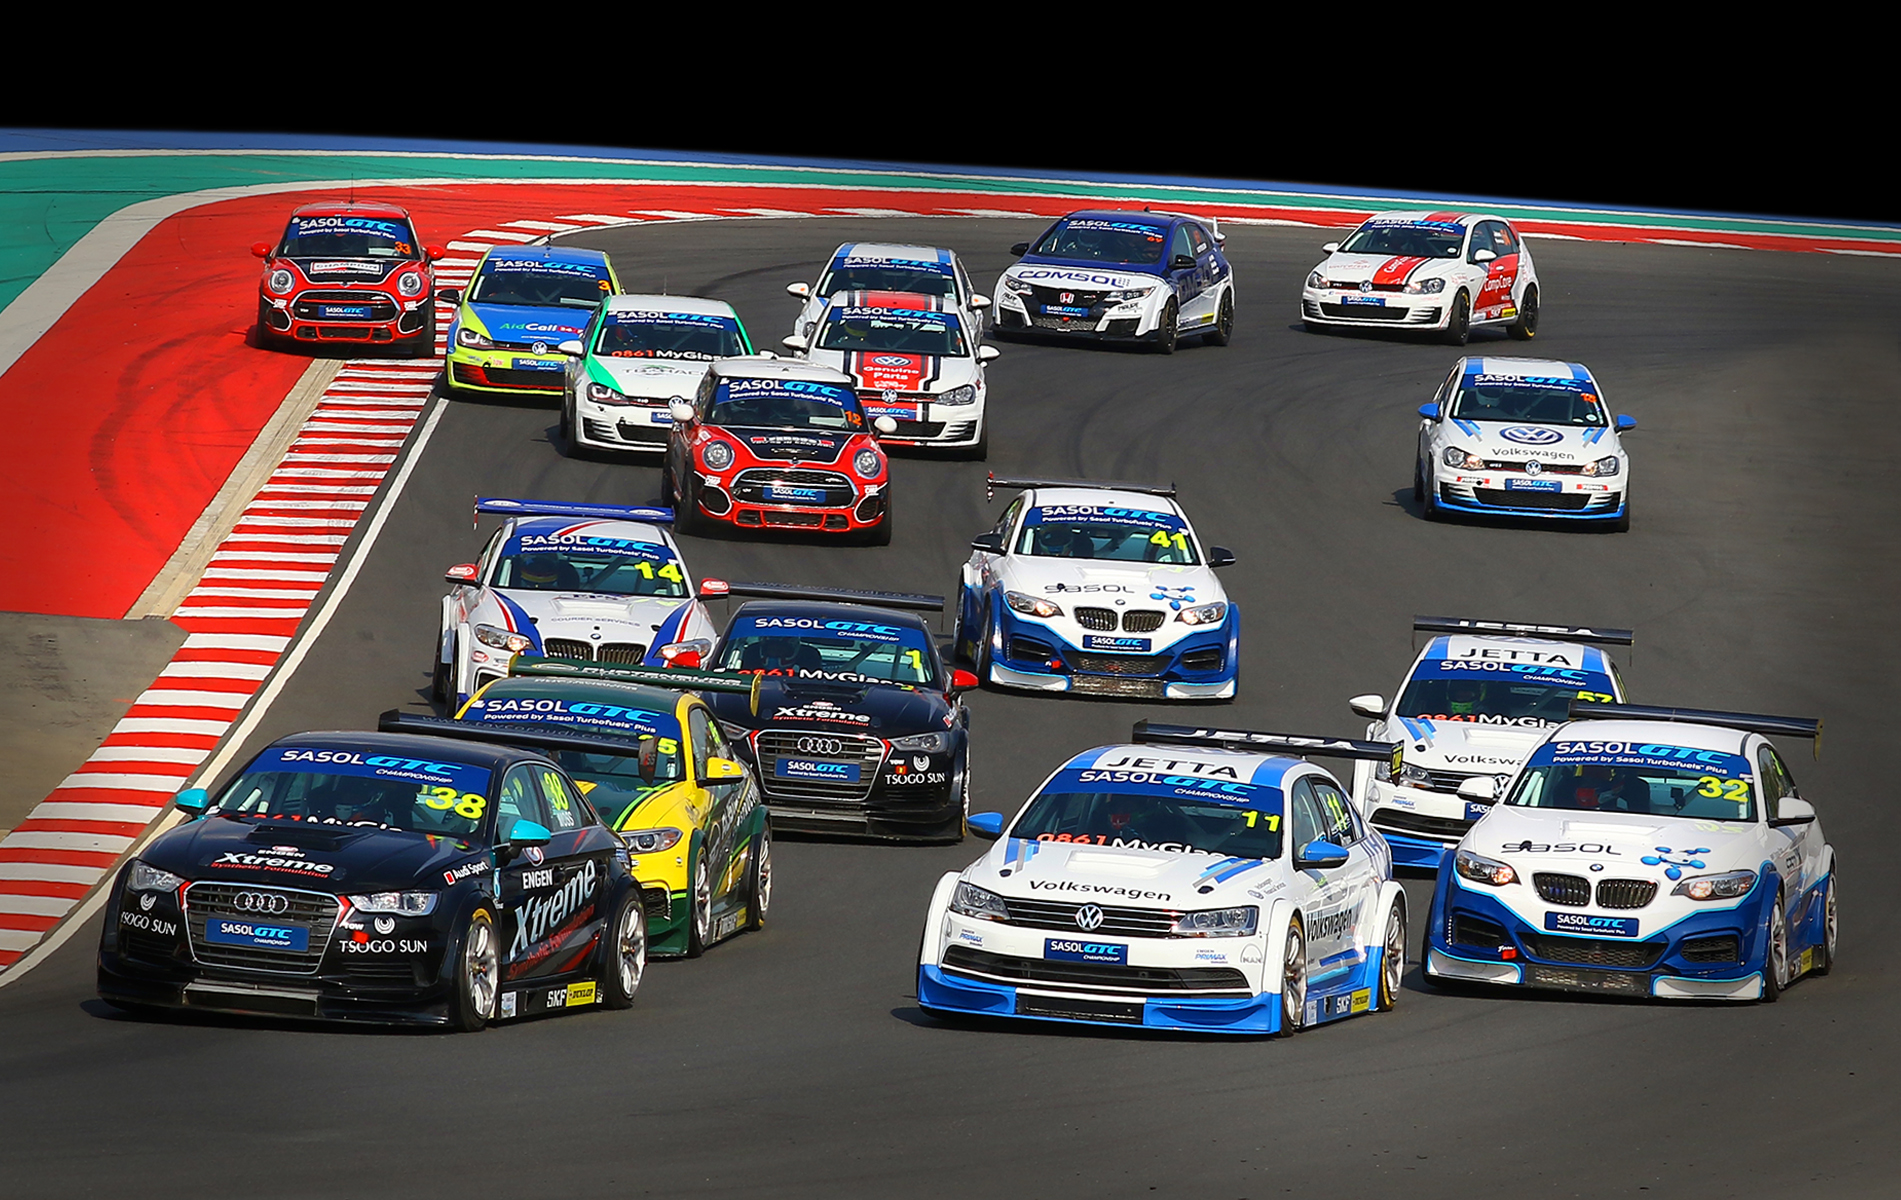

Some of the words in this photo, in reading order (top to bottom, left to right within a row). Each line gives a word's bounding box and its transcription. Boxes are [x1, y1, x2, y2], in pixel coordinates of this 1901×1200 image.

[299, 218, 345, 230] SASOL
[345, 218, 396, 232] GTC
[1110, 222, 1158, 232] GTC
[394, 241, 411, 255] 33
[495, 260, 543, 268] SASOL
[543, 262, 596, 273] GTC
[844, 256, 890, 265] SASOL
[890, 258, 941, 268] GTC
[598, 280, 611, 291] 3
[1017, 270, 1123, 288] COMSOL
[617, 311, 668, 319] SASOL
[668, 313, 723, 323] GTC
[842, 307, 892, 315] SASOL
[891, 309, 946, 320] GTC
[500, 323, 557, 332] AidCall
[611, 349, 654, 357] 0861
[863, 365, 919, 374] Genuine
[873, 371, 908, 380] Parts
[729, 380, 784, 393] SASOL
[784, 381, 842, 397] GTC
[1474, 374, 1525, 382] SASOL
[1525, 376, 1581, 387] GTC
[845, 410, 862, 426] 12
[1492, 448, 1575, 460] Volkswagen
[1042, 506, 1104, 516] SASOL
[1103, 507, 1170, 522] GTC
[1155, 522, 1172, 530] Plus
[520, 536, 587, 546] SASOL
[587, 537, 658, 552] GTC
[1150, 530, 1187, 550] 41
[521, 545, 559, 553] Powered
[641, 552, 660, 560] Plus
[635, 561, 683, 584] 14
[755, 618, 825, 629] SASOL
[825, 621, 901, 635] GTC
[837, 631, 900, 642] CHAMPIONSHIP
[1092, 636, 1116, 645] SASOL
[1115, 638, 1142, 646] GTC
[905, 649, 920, 669] 1
[1460, 648, 1572, 666] JETTA
[1440, 660, 1511, 671] SASOL
[1511, 664, 1588, 680] GTC
[1523, 674, 1586, 686] CHAMPIONSHIP
[1577, 690, 1614, 703] 57
[487, 699, 568, 713] SASOL
[568, 702, 660, 722] GTC
[774, 707, 871, 723] Xtreme
[484, 713, 530, 721] Powered
[531, 713, 544, 722] by
[546, 714, 574, 722] Sasol
[634, 723, 657, 733] Plus
[1555, 741, 1637, 755] SASOL
[1638, 743, 1731, 764] GTC
[281, 751, 364, 765] SASOL
[365, 755, 462, 775] GTC
[788, 761, 816, 771] SASOL
[816, 763, 848, 773] GTC
[1107, 757, 1238, 779] JETTA
[1552, 755, 1598, 763] Powered
[1616, 756, 1644, 764] Sasol
[1705, 765, 1728, 775] Plus
[375, 768, 453, 784] CHAMPIONSHIP
[885, 773, 925, 785] TSOGO
[927, 773, 945, 784] SUN
[1078, 770, 1163, 784] SASOL
[1163, 775, 1257, 795] GTC
[543, 772, 569, 810] 38
[1174, 788, 1250, 804] CHAMPIONSHIP
[1698, 776, 1749, 802] 32
[425, 786, 487, 820] 38
[1326, 792, 1347, 831] 11
[1241, 810, 1281, 832] 11
[1035, 832, 1106, 846] 0861
[257, 849, 305, 858] ENGEN
[211, 862, 262, 872] Synthetic
[263, 865, 329, 878] Formulation
[214, 852, 334, 874] Xtreme
[453, 867, 470, 881] Audi
[469, 860, 489, 874] Sport
[522, 869, 554, 890] ENGEN
[1029, 880, 1171, 901] Volkswagen
[509, 858, 597, 962] Xtreme
[151, 919, 177, 936] SUN
[1306, 909, 1353, 942] Volkswagen
[1557, 914, 1589, 926] SASOL
[1589, 917, 1626, 928] GTC
[220, 923, 254, 937] SASOL
[254, 927, 293, 939] GTC
[254, 937, 291, 946] CHAMPIONSHIP
[339, 939, 396, 954] TSOGO
[399, 940, 428, 953] SUN
[1051, 940, 1084, 952] SASOL
[1084, 943, 1122, 955] GTC
[1083, 954, 1120, 962] CHAMPIONSHIP
[546, 989, 567, 1008] SKF
[572, 988, 594, 999] DUNLOP
[1336, 995, 1350, 1014] SKF
